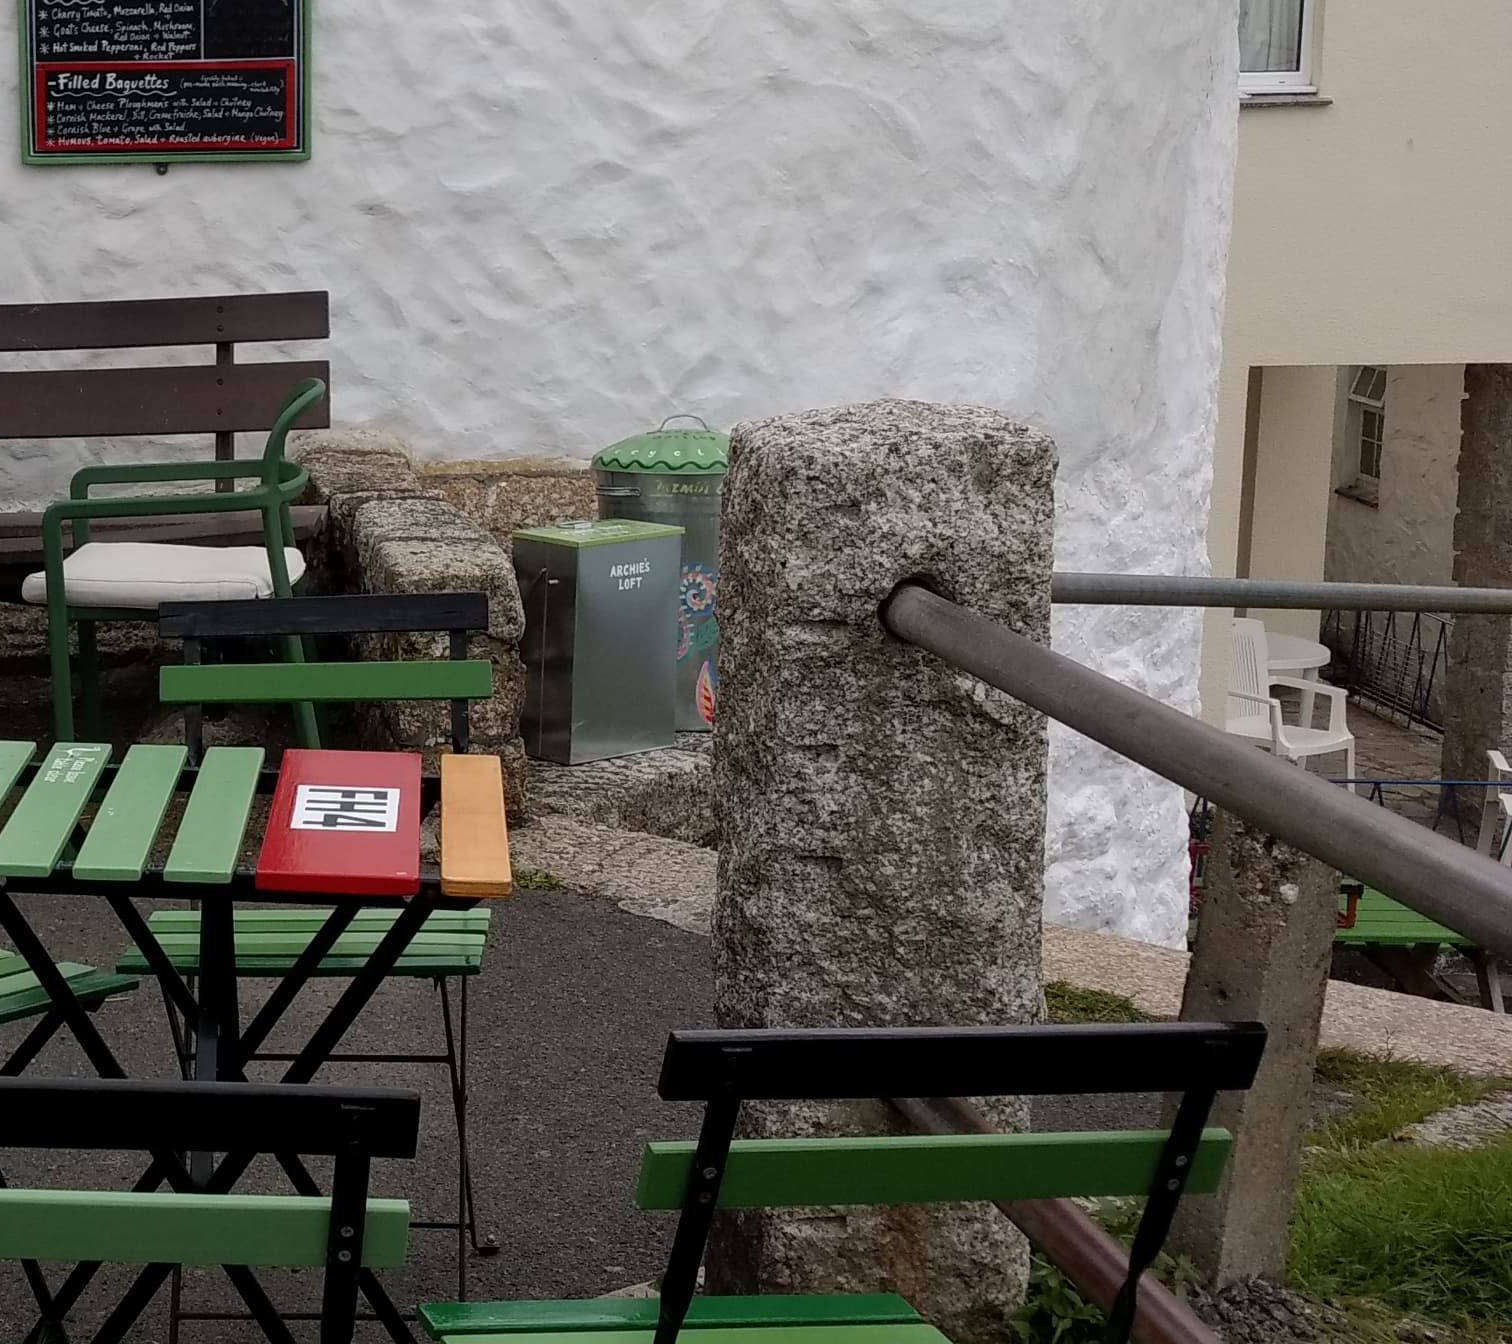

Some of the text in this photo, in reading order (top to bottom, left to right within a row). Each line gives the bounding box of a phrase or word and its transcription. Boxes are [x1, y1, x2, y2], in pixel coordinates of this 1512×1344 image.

[58, 73, 99, 90] Filled
[105, 73, 169, 94] Baguettes
[609, 558, 651, 578] ARCHIE'S
[618, 577, 643, 591] LOFT
[302, 788, 389, 827] FH4
